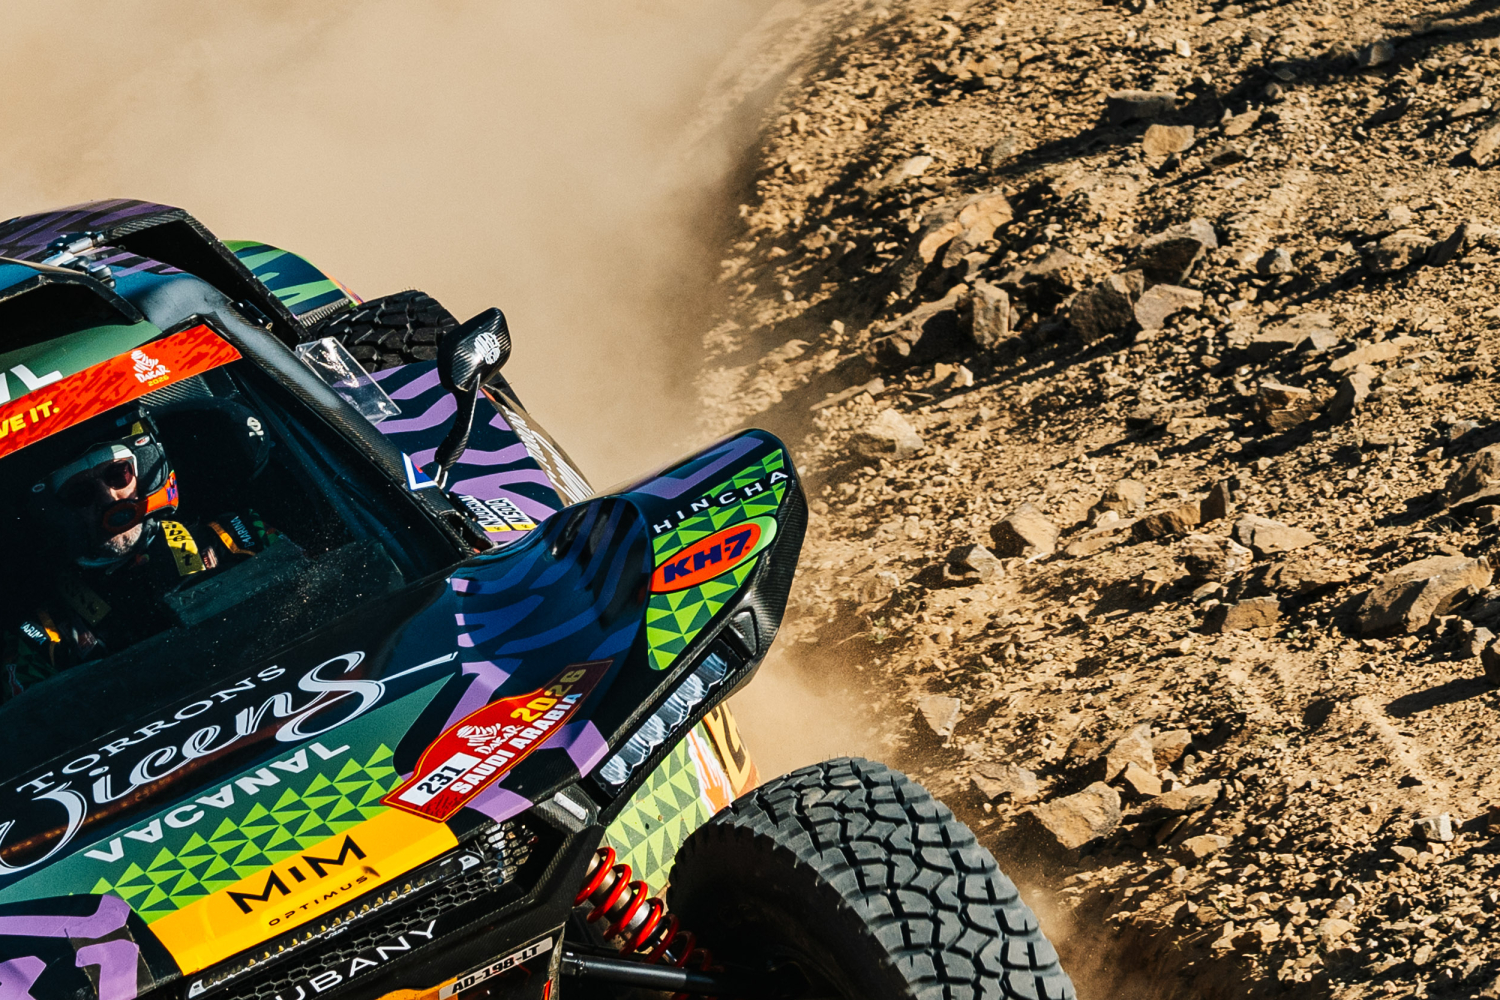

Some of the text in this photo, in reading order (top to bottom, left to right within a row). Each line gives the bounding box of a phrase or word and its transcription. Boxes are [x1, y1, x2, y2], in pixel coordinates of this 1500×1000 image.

[134, 364, 171, 383] DAKAR
[30, 400, 61, 425] IT.
[652, 471, 789, 534] HINCHA
[664, 529, 752, 584] KH-7
[510, 668, 587, 723] 2026
[16, 665, 286, 794] TORRONS
[449, 692, 583, 795] SAUDI ARABIA
[474, 724, 525, 755] DAKAR
[83, 741, 351, 863] VACANAL
[416, 765, 467, 796] 231
[268, 875, 369, 927] OPTIMUS
[451, 943, 541, 995] AD-198-LT
